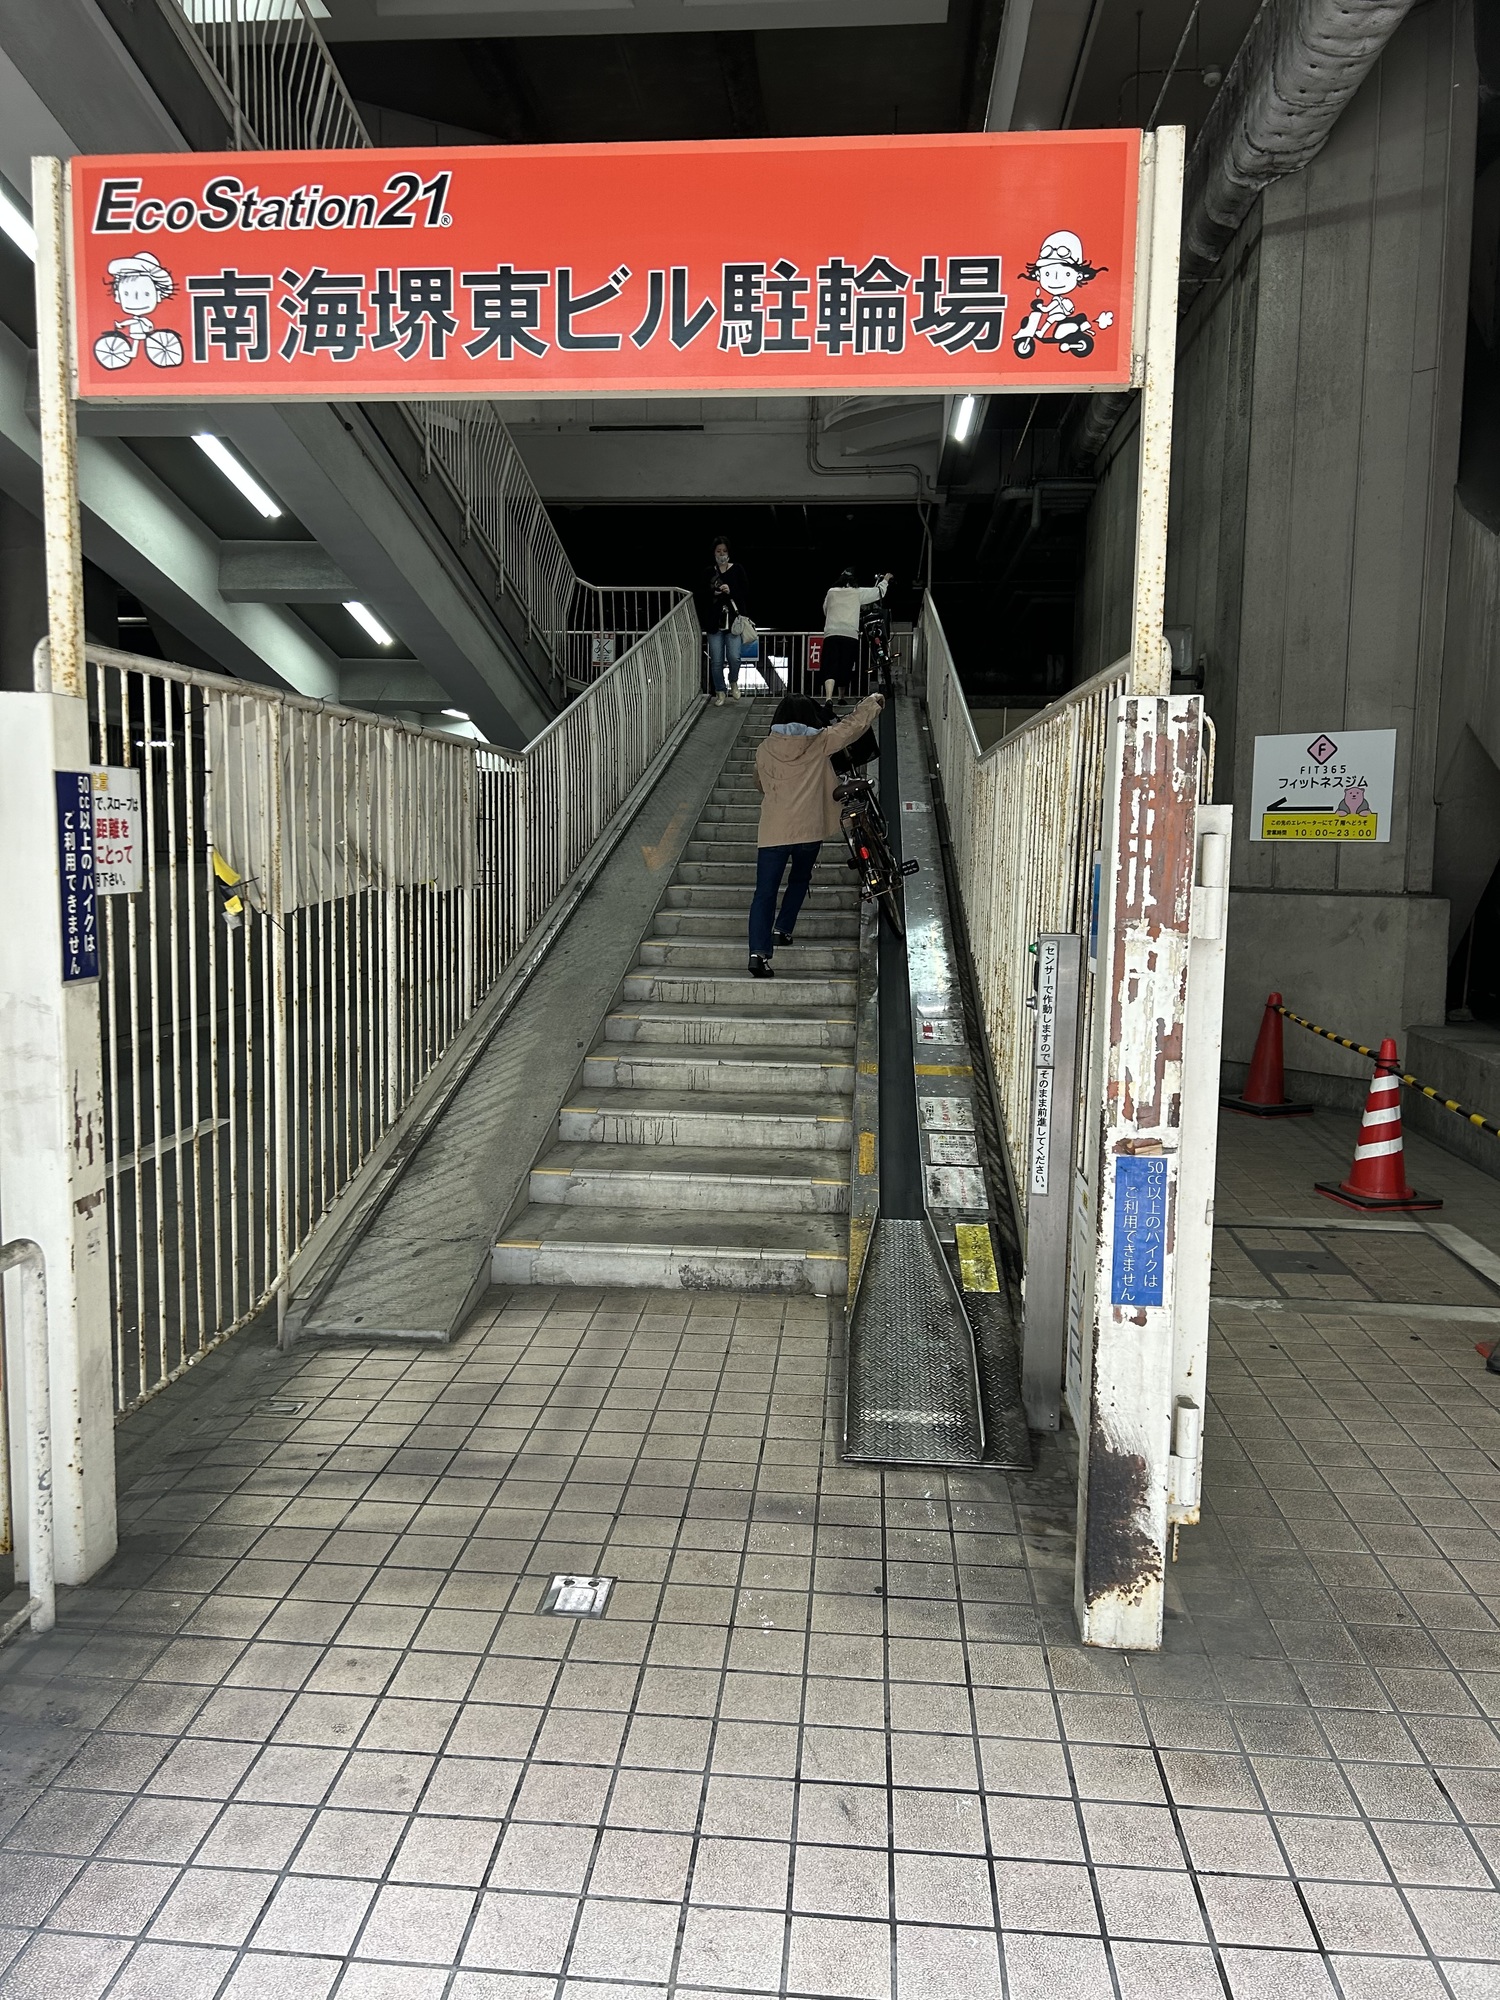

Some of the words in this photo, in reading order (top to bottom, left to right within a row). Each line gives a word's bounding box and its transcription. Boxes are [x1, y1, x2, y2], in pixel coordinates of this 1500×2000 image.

[186, 256, 1006, 363] 南海堺東ビル駐輪場
[1278, 776, 1368, 789] フィットネスジム
[1300, 765, 1346, 774] FIT365
[96, 818, 129, 839] 距離を
[64, 811, 81, 975] ご利用できません
[1121, 1186, 1139, 1301] ご利用できません
